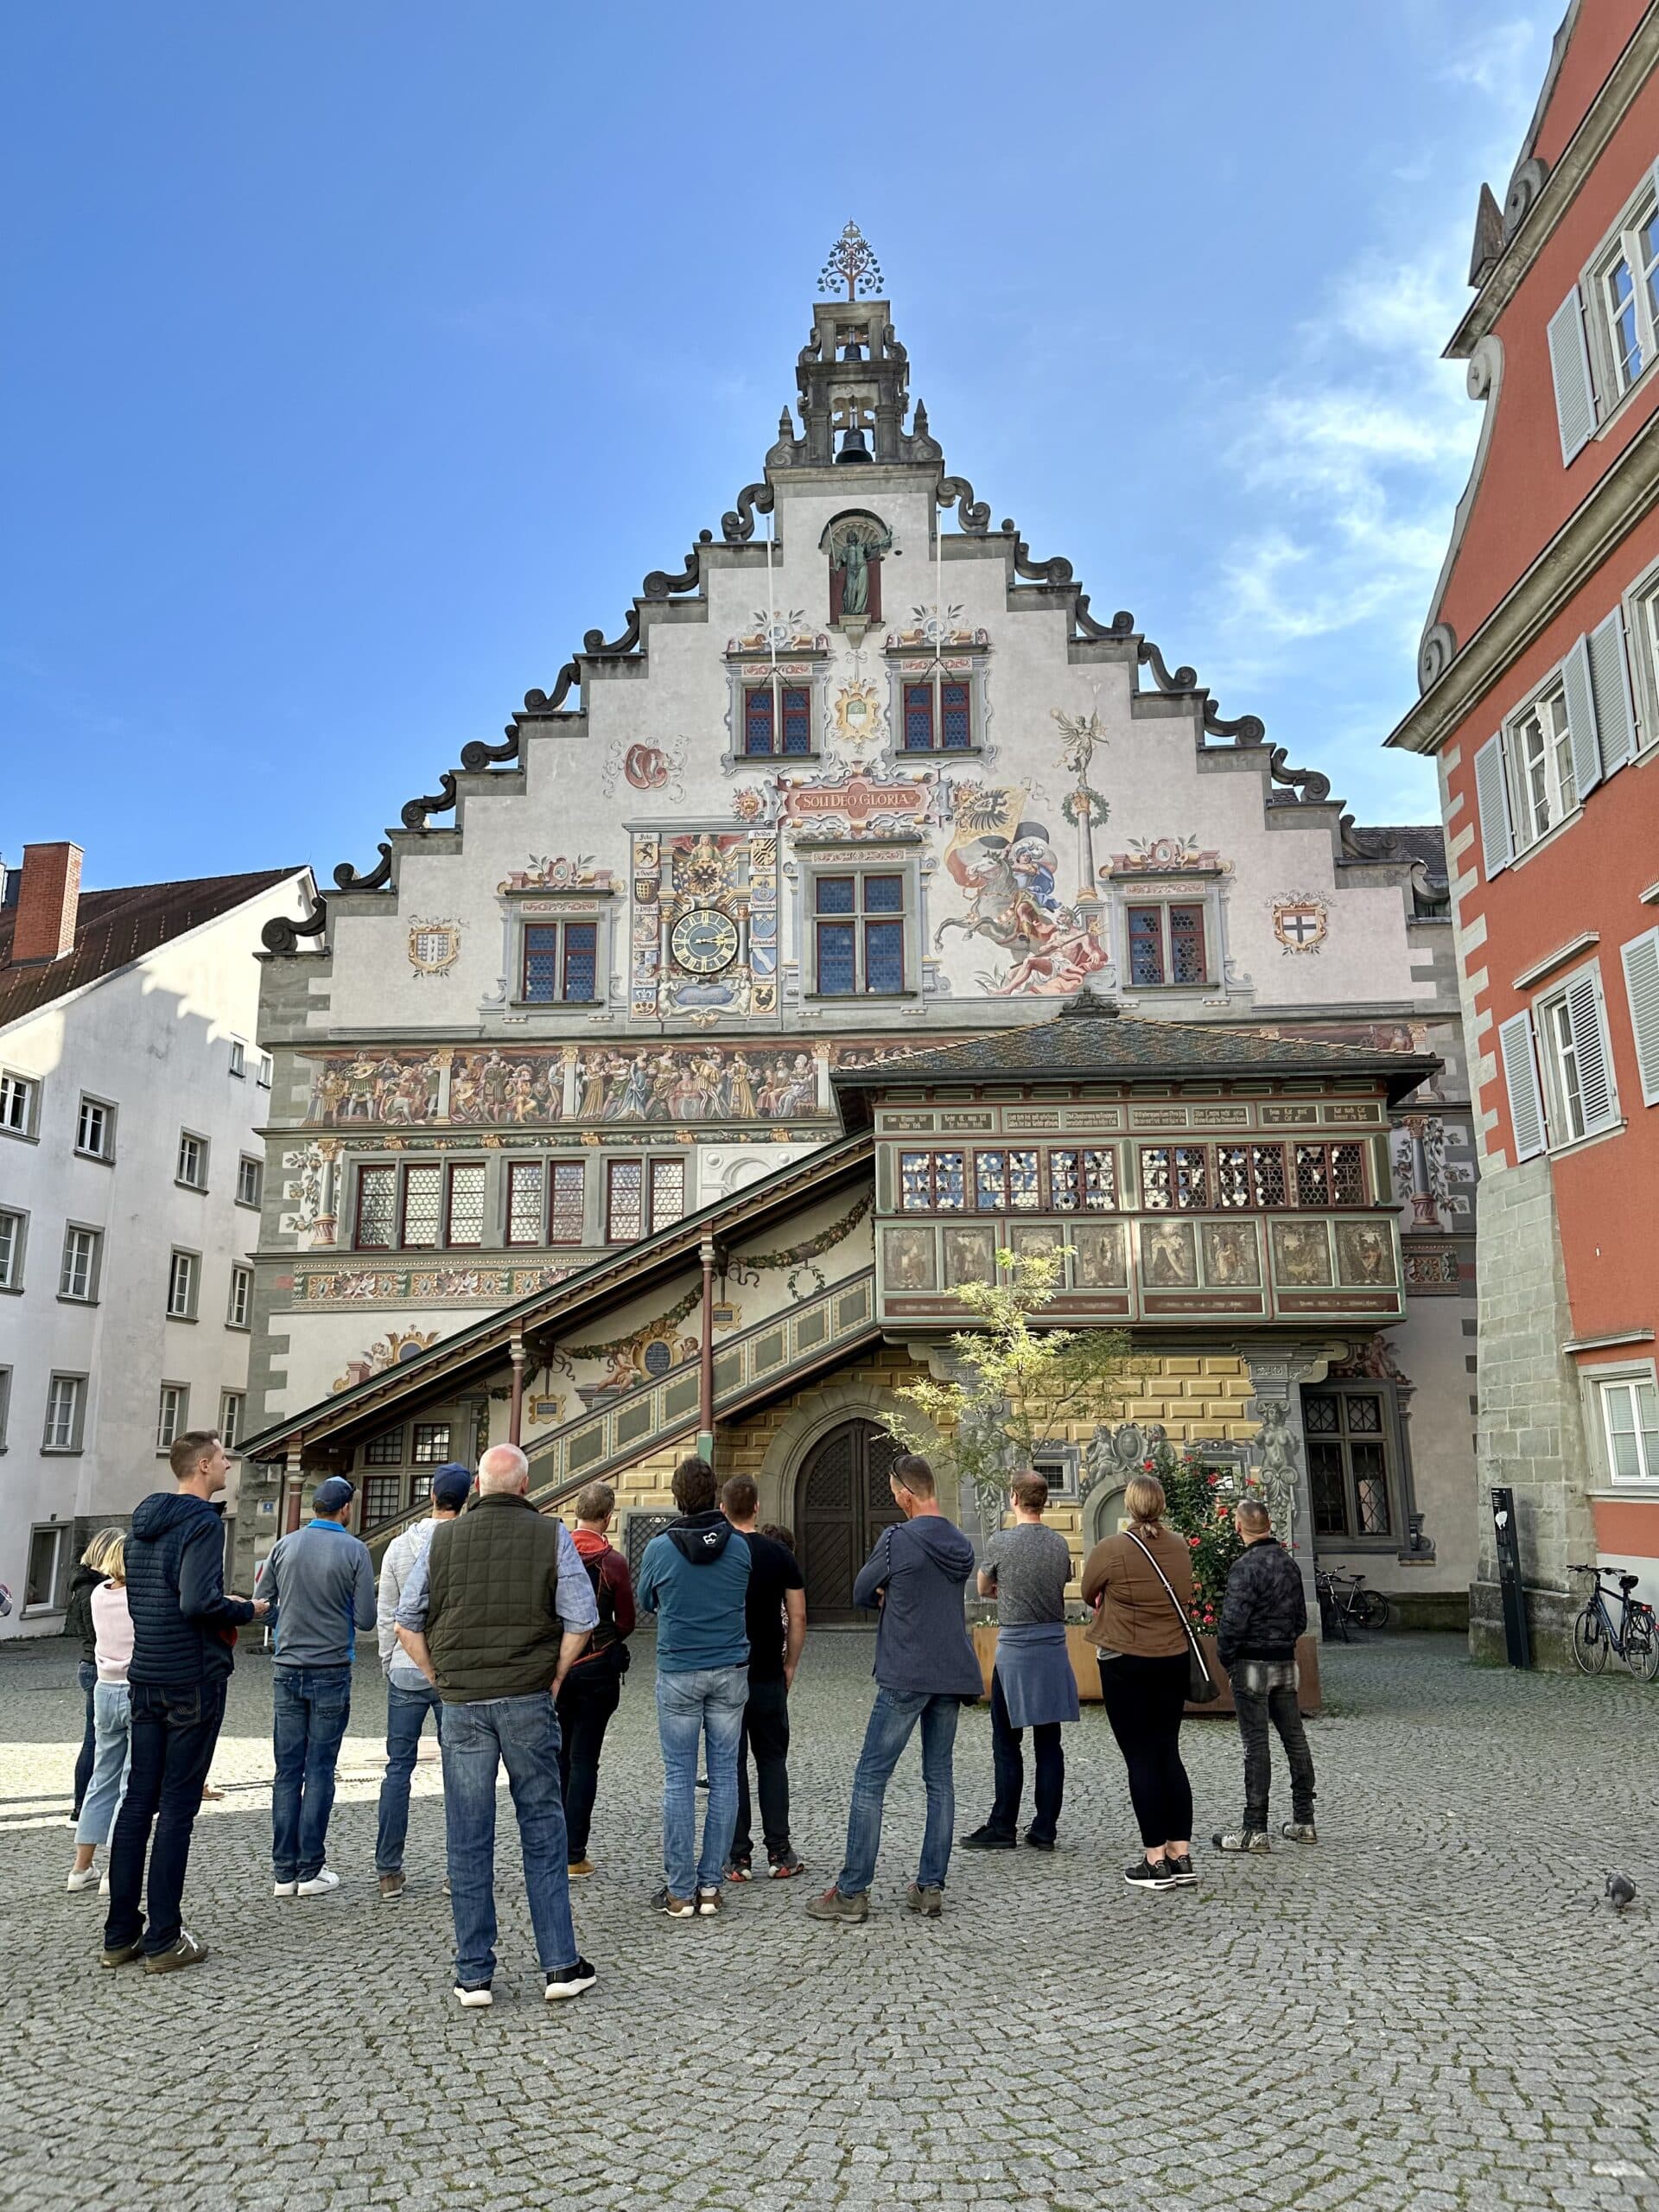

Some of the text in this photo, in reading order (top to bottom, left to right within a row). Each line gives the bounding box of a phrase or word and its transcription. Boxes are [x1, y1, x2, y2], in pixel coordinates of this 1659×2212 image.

[803, 793, 910, 808] SOLI DEO GLORIA
